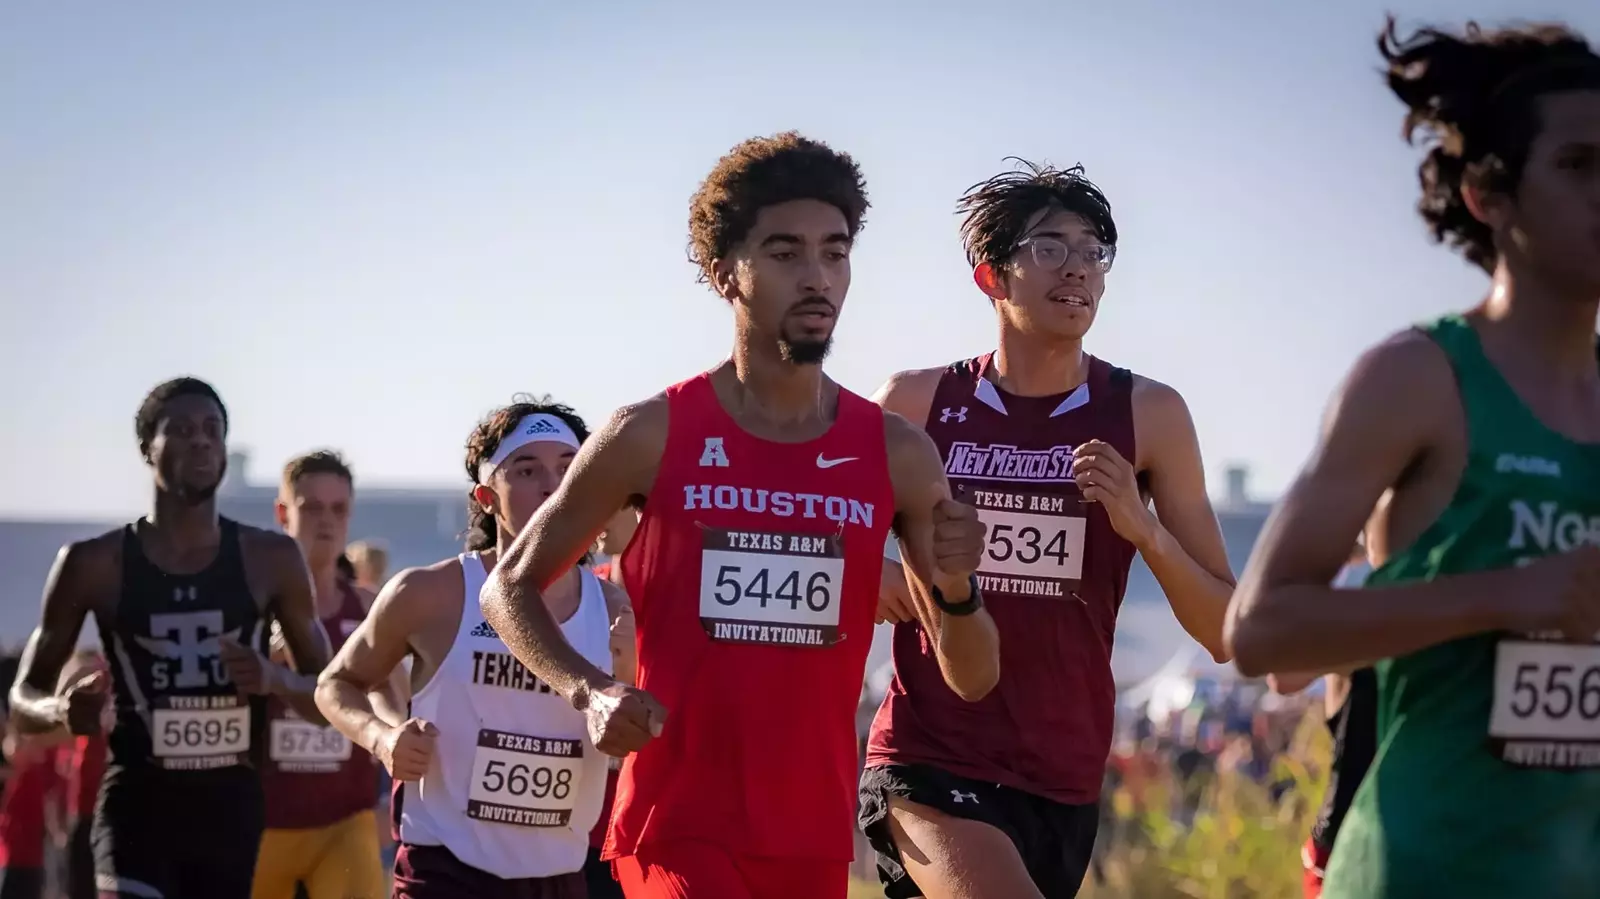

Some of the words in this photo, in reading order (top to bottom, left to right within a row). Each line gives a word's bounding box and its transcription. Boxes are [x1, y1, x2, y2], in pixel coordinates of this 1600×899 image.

[526, 427, 561, 435] adidas
[683, 484, 875, 528] HOUSTON
[974, 490, 1024, 509] TEXAS
[1029, 496, 1064, 512] A&M
[727, 531, 783, 551] TEXAS
[789, 536, 826, 554] A&M
[986, 524, 1069, 566] 534
[714, 565, 831, 612] 5446
[977, 575, 1064, 596] VITATIONAL
[714, 623, 824, 646] INVITATIONAL
[164, 718, 241, 747] 5695
[497, 733, 541, 752] TEXAS
[544, 740, 572, 755] A&M
[482, 760, 572, 799] 5698
[479, 804, 561, 825] INVITATIONAL
